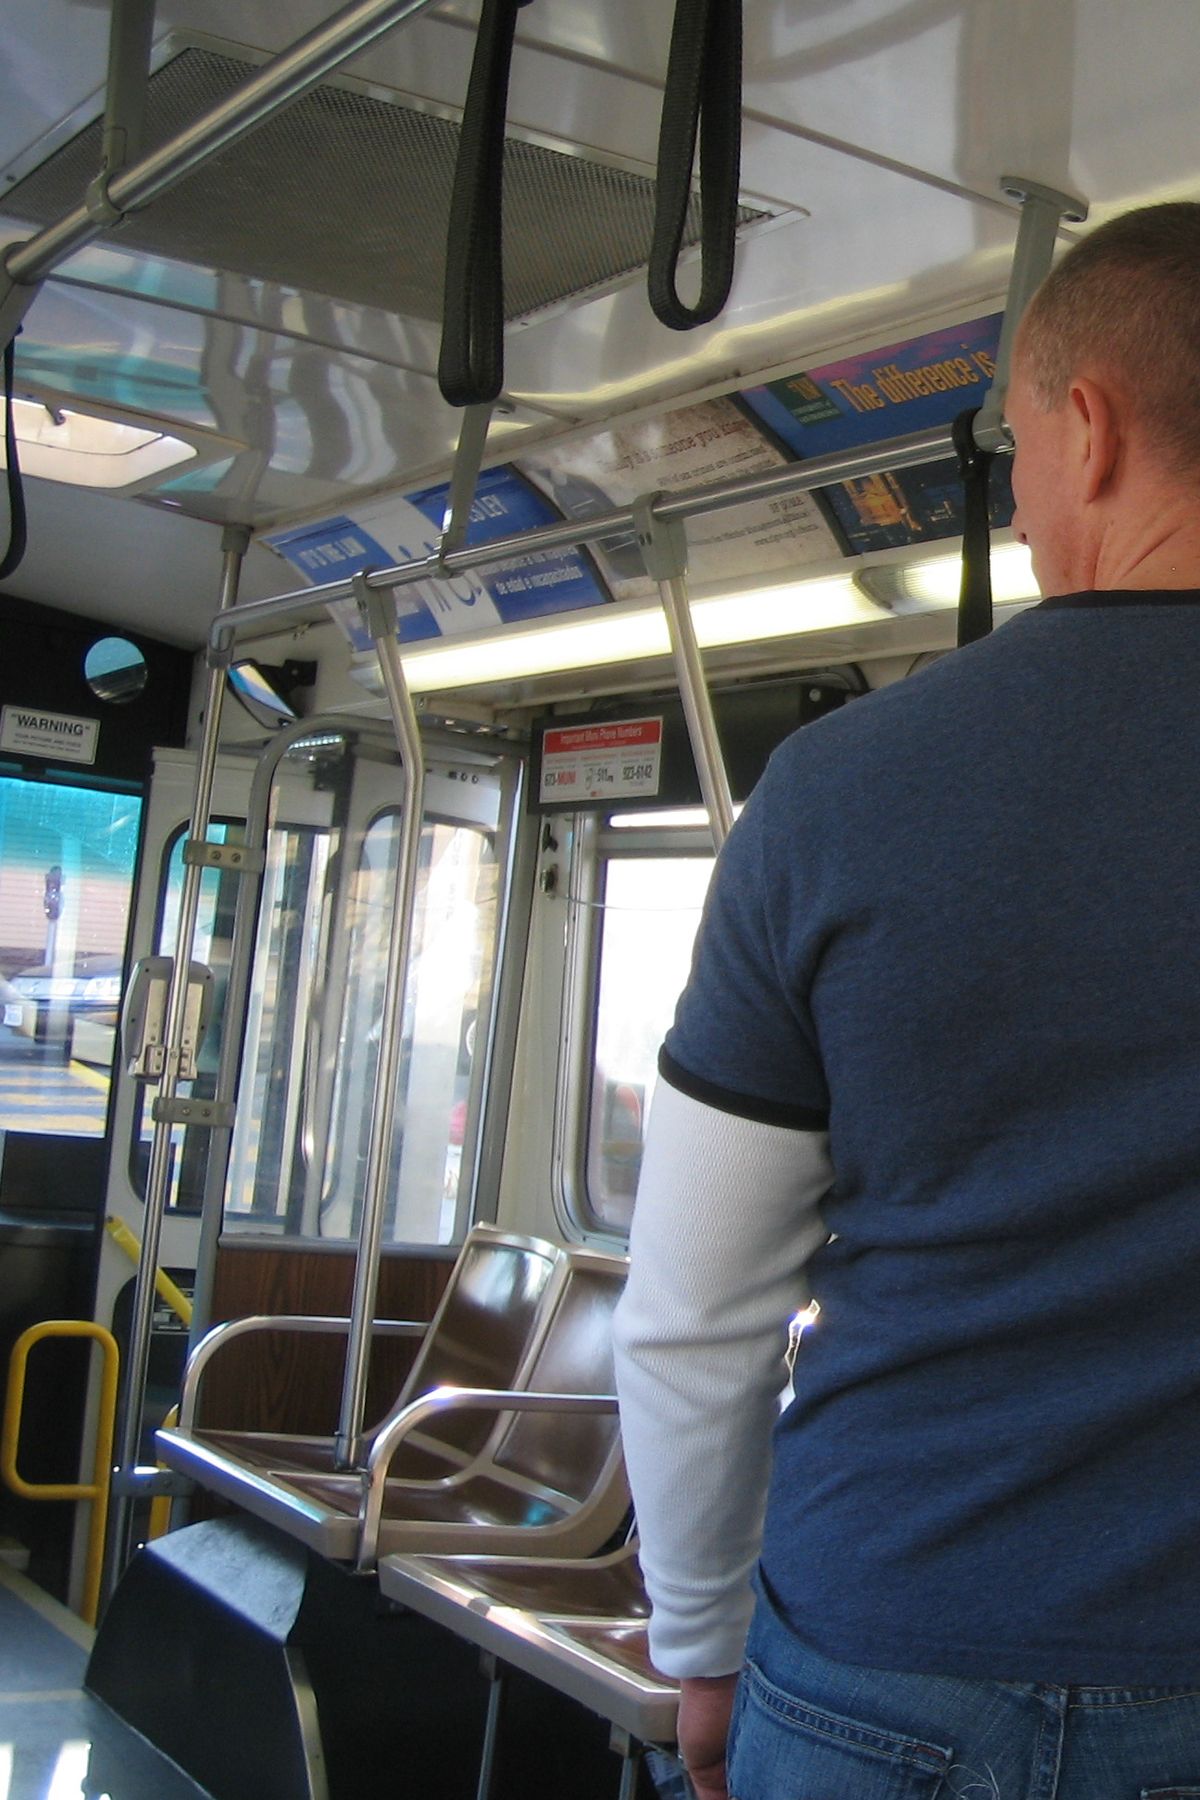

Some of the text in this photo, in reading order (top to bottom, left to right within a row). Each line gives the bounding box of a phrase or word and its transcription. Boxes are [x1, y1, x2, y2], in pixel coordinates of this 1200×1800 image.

[831, 378, 886, 413] The
[871, 356, 981, 405] difference
[959, 343, 997, 380] is
